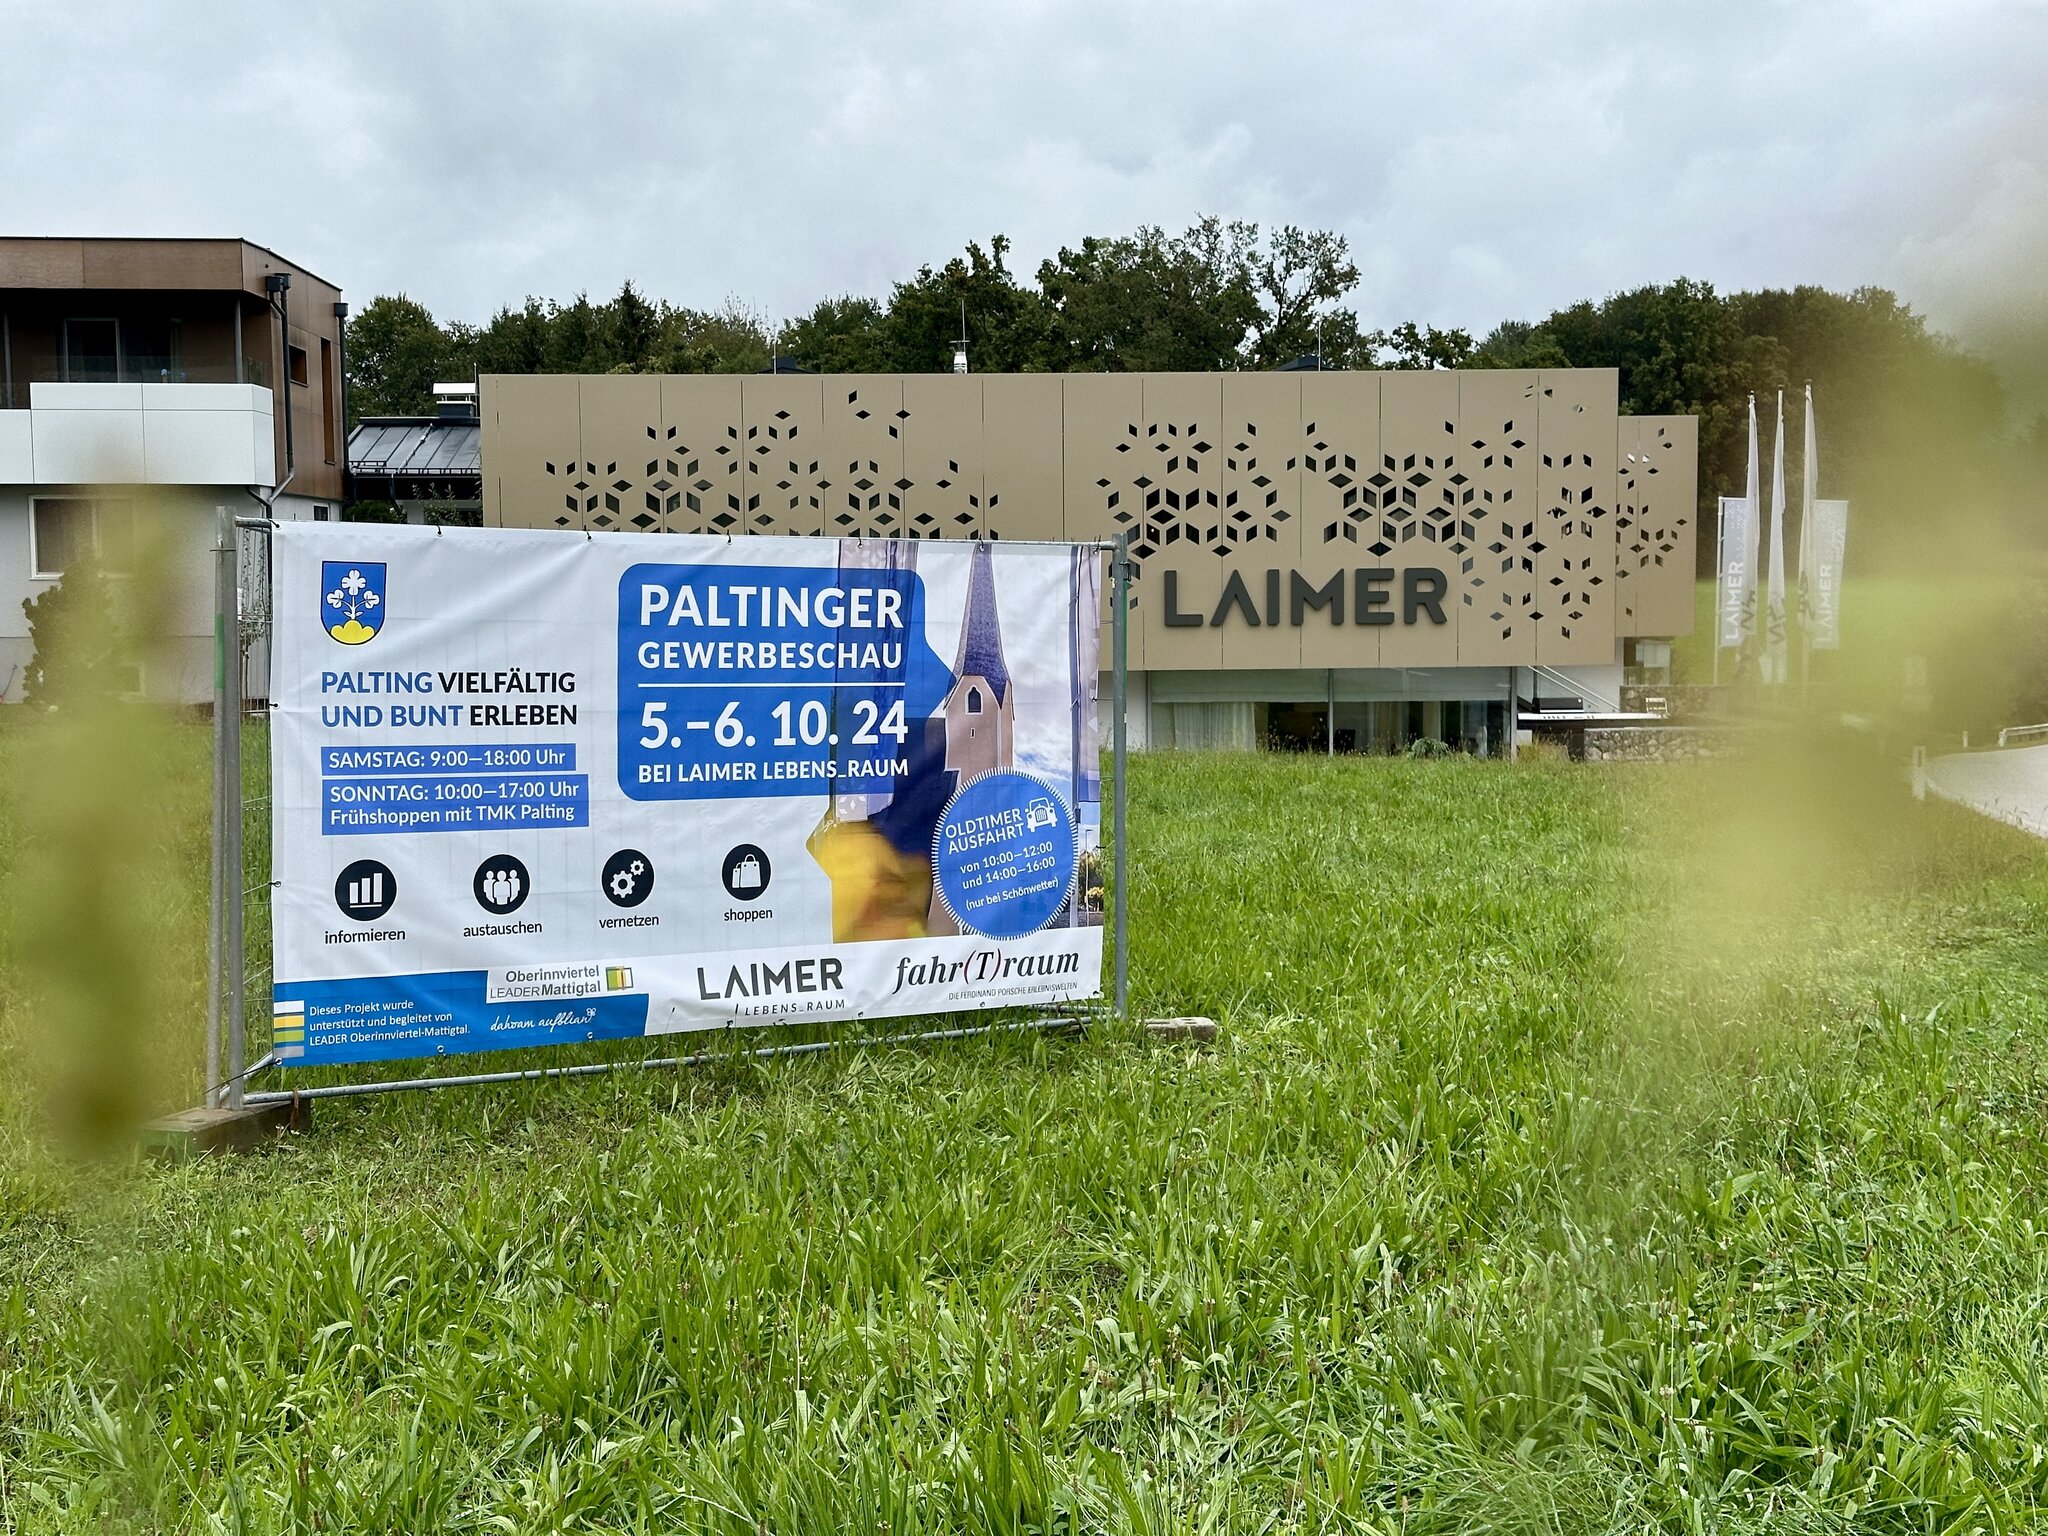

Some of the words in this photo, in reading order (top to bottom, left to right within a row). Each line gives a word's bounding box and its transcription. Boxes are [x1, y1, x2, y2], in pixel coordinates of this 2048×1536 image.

[640, 584, 904, 629] PALTINGER
[1164, 567, 1448, 627] LAIMER
[1724, 561, 1744, 640] LAIMER
[1815, 564, 1833, 641] LAIMER
[637, 641, 902, 669] GEWERBESCHAU
[321, 671, 433, 693] PALTING
[437, 667, 576, 693] VIELFÄLTIG
[321, 705, 383, 727] UND
[390, 705, 463, 727] BUNT
[469, 704, 577, 726] ERLEBEN
[771, 700, 839, 746] 10.
[851, 699, 909, 745] 24
[329, 751, 425, 769] SAMSTAG:
[536, 749, 566, 765] Uhr
[638, 764, 671, 783] BEI
[678, 762, 757, 782] LAIMER
[762, 759, 909, 780] LEBENS_RAUM
[330, 784, 429, 803] SONNTAG:
[549, 781, 579, 798] Uhr
[330, 808, 440, 826] Frühshoppen
[445, 806, 472, 822] mit
[476, 805, 516, 821] TMK
[521, 803, 575, 821] Palting
[945, 808, 1023, 839] OLDTIMER
[948, 823, 1025, 855] AUSFAHRT
[959, 862, 980, 874] von
[962, 875, 983, 890] und
[965, 898, 984, 911] (nur
[986, 893, 1001, 905] bei
[1002, 876, 1059, 901] Schönwetter)
[599, 913, 660, 929] vernetzen
[723, 908, 773, 925] shoppen
[324, 928, 406, 945] informieren
[463, 920, 543, 938] austauschen
[505, 965, 600, 983] Oberinnviertel
[697, 957, 844, 1001] LAIMER
[892, 948, 1080, 994] fahr(T)raum
[948, 992, 960, 1000] DIE
[960, 988, 997, 999] FERDINAND
[997, 986, 1027, 996] PORSCHE
[1027, 982, 1078, 994] ERLEBNISWELTEN
[309, 1005, 341, 1016] Dieses
[344, 1001, 380, 1015] Projekt
[382, 999, 414, 1011] wurde
[745, 999, 845, 1016] LEBENS_RAUM
[309, 1017, 365, 1031] unterstützt
[367, 1016, 387, 1027] und
[389, 1013, 432, 1026] begleitet
[434, 1012, 453, 1022] von
[490, 1014, 535, 1032] dahoam
[309, 1034, 348, 1046] LEADER
[350, 1024, 471, 1043] Oberinnviertel-Mattigtal.
